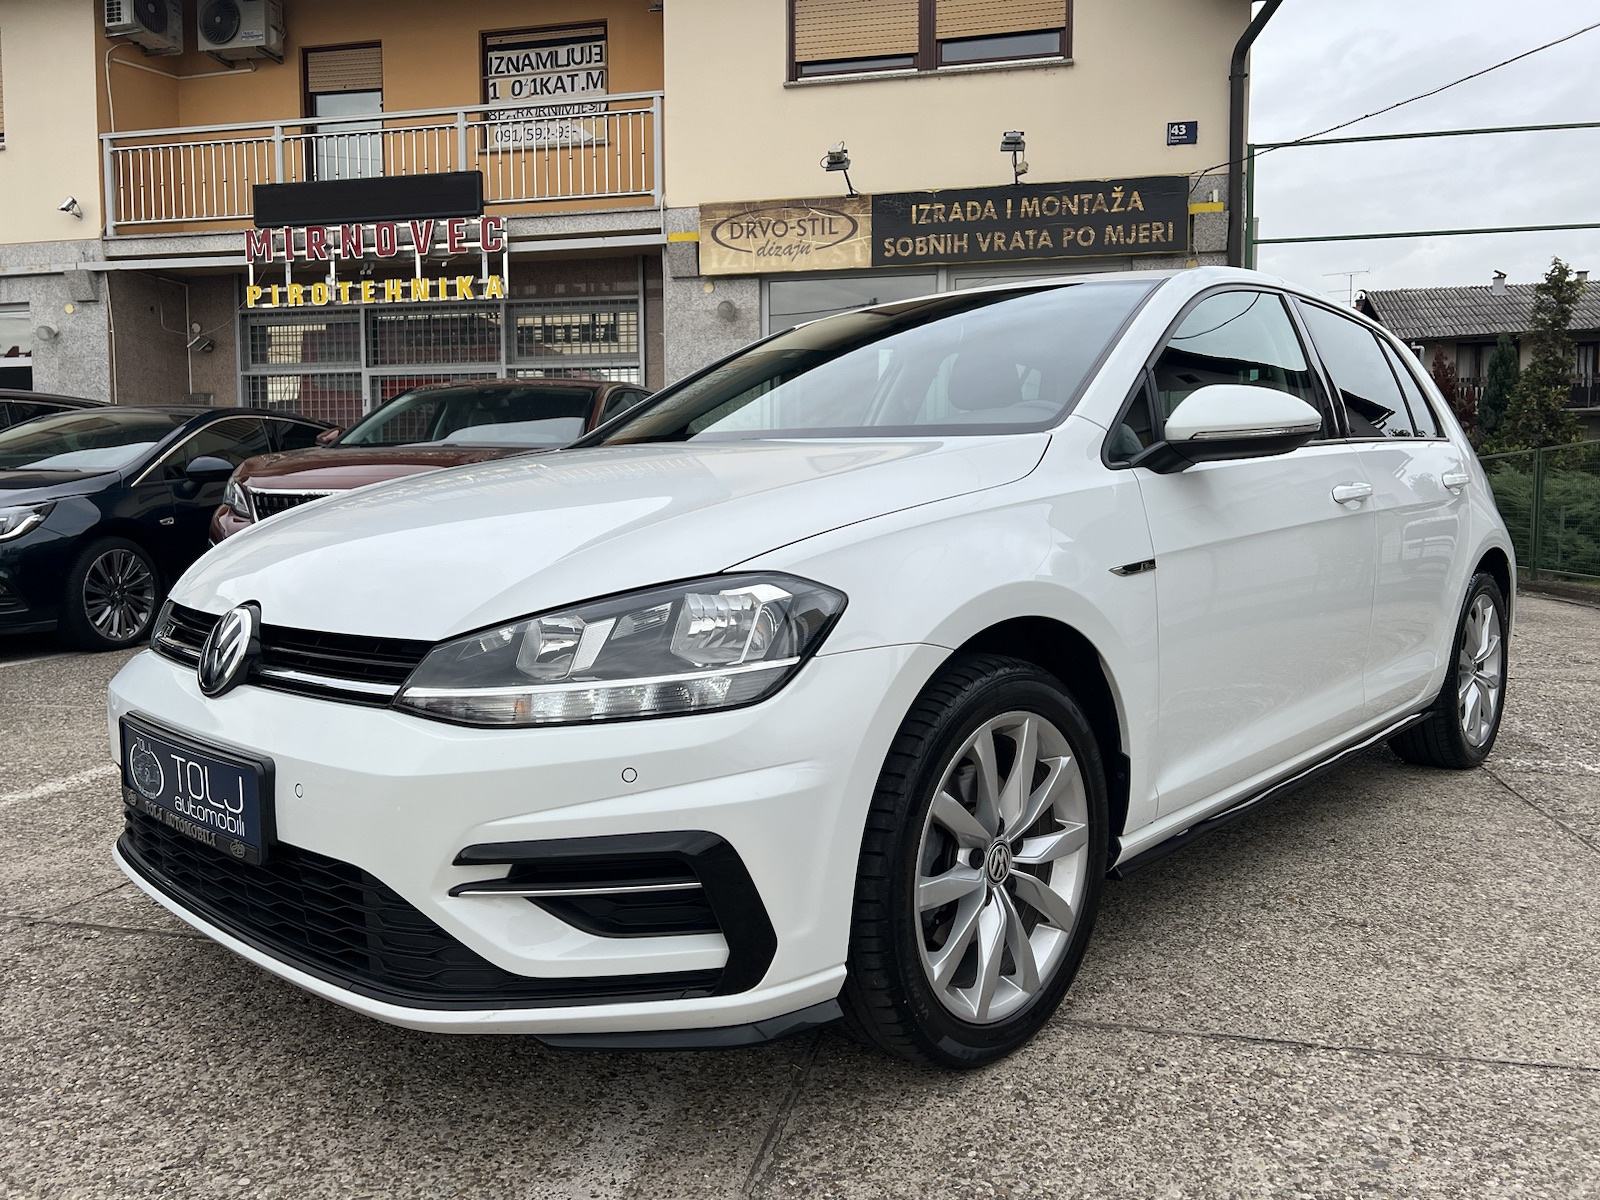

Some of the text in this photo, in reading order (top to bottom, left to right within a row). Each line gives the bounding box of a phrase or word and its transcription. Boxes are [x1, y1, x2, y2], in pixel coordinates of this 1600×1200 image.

[1171, 124, 1187, 135] 43
[911, 185, 1145, 225] IZRADA I MONTAŽA
[244, 216, 503, 264] MIRNOVEC
[730, 217, 838, 240] DRVO-STIL
[883, 233, 969, 258] SOBNIH
[976, 228, 1054, 253] VRATA
[1062, 225, 1096, 249] PO
[1104, 221, 1174, 246] MJERI
[756, 239, 813, 262] dizajn
[246, 274, 504, 309] PIROTEHNIKA
[170, 753, 244, 814] TOLJ
[174, 795, 245, 838] automobili
